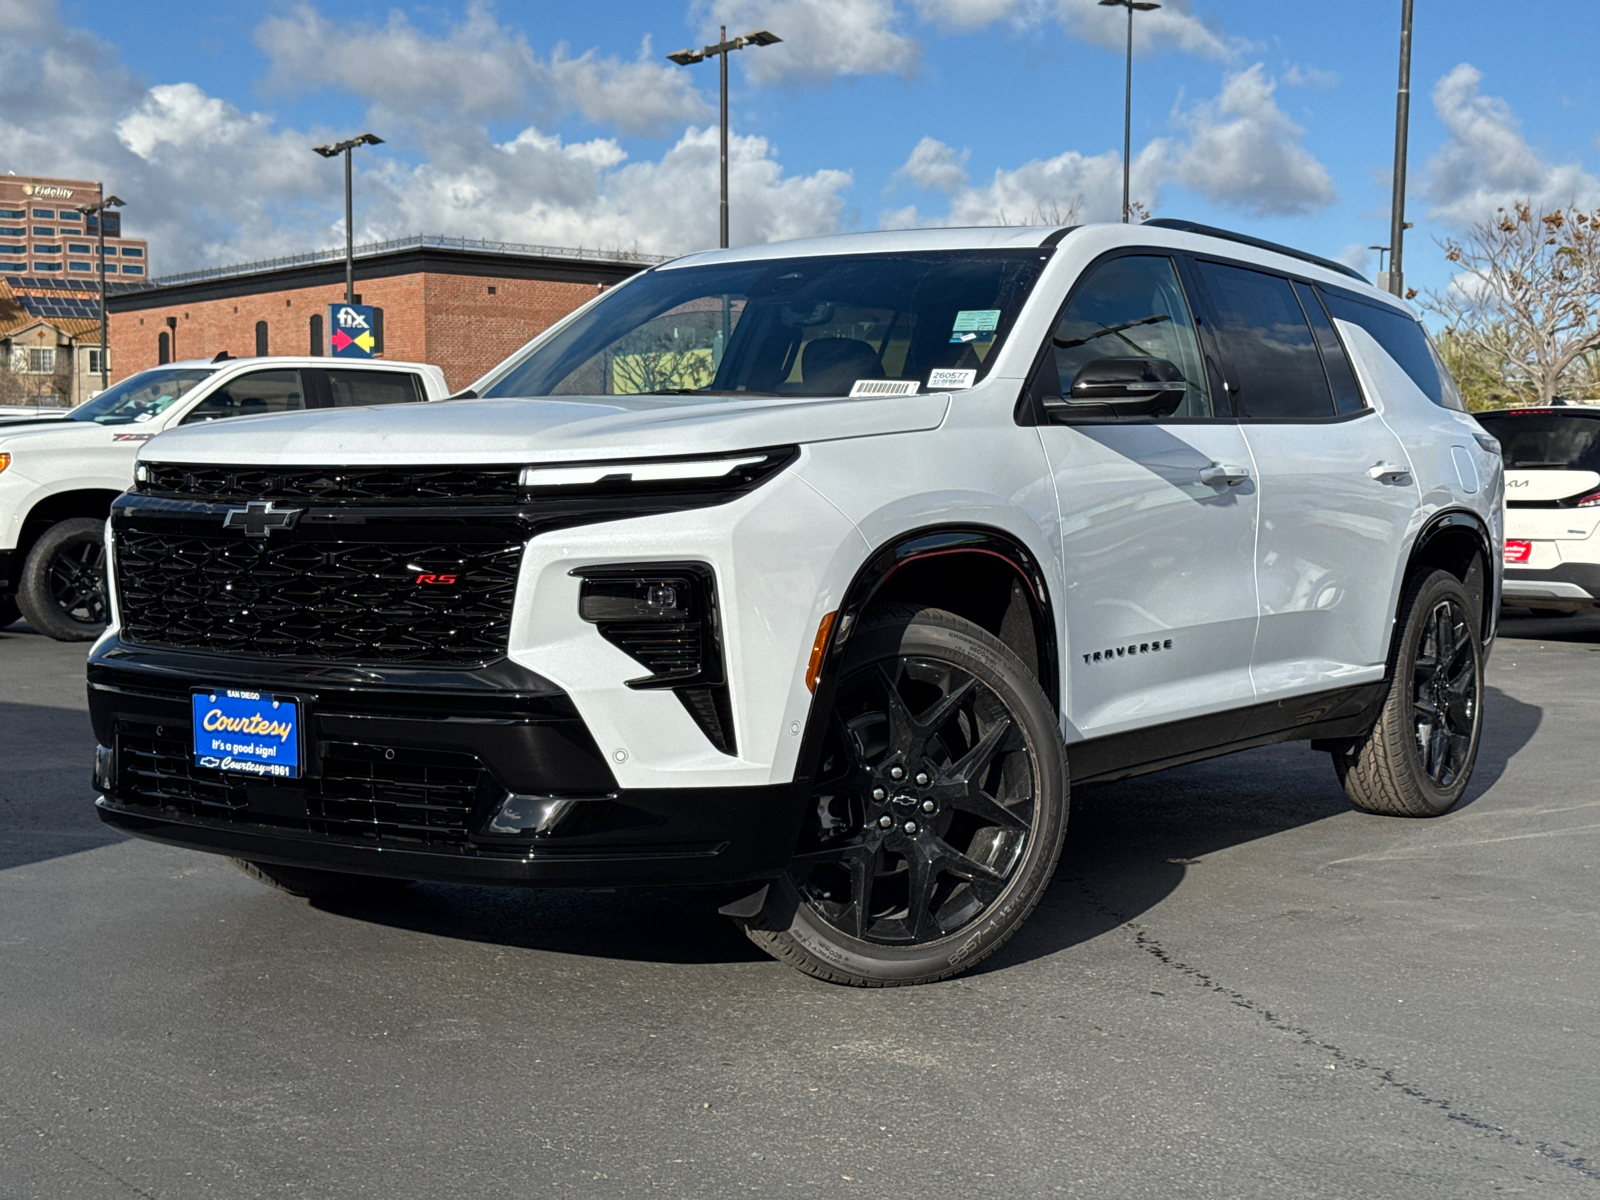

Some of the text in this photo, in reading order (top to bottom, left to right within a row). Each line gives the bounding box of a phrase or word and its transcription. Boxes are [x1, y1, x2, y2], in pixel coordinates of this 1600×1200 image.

[34, 186, 74, 199] Fidelity
[336, 307, 370, 328] fix
[416, 574, 457, 584] RS
[1083, 639, 1173, 664] TRAVERSE
[227, 690, 260, 700] SAN DIEGO
[203, 709, 292, 742] Courtesy
[212, 739, 225, 751] It's
[233, 743, 254, 754] good
[255, 744, 277, 758] sign!
[221, 756, 267, 776] Courtesy
